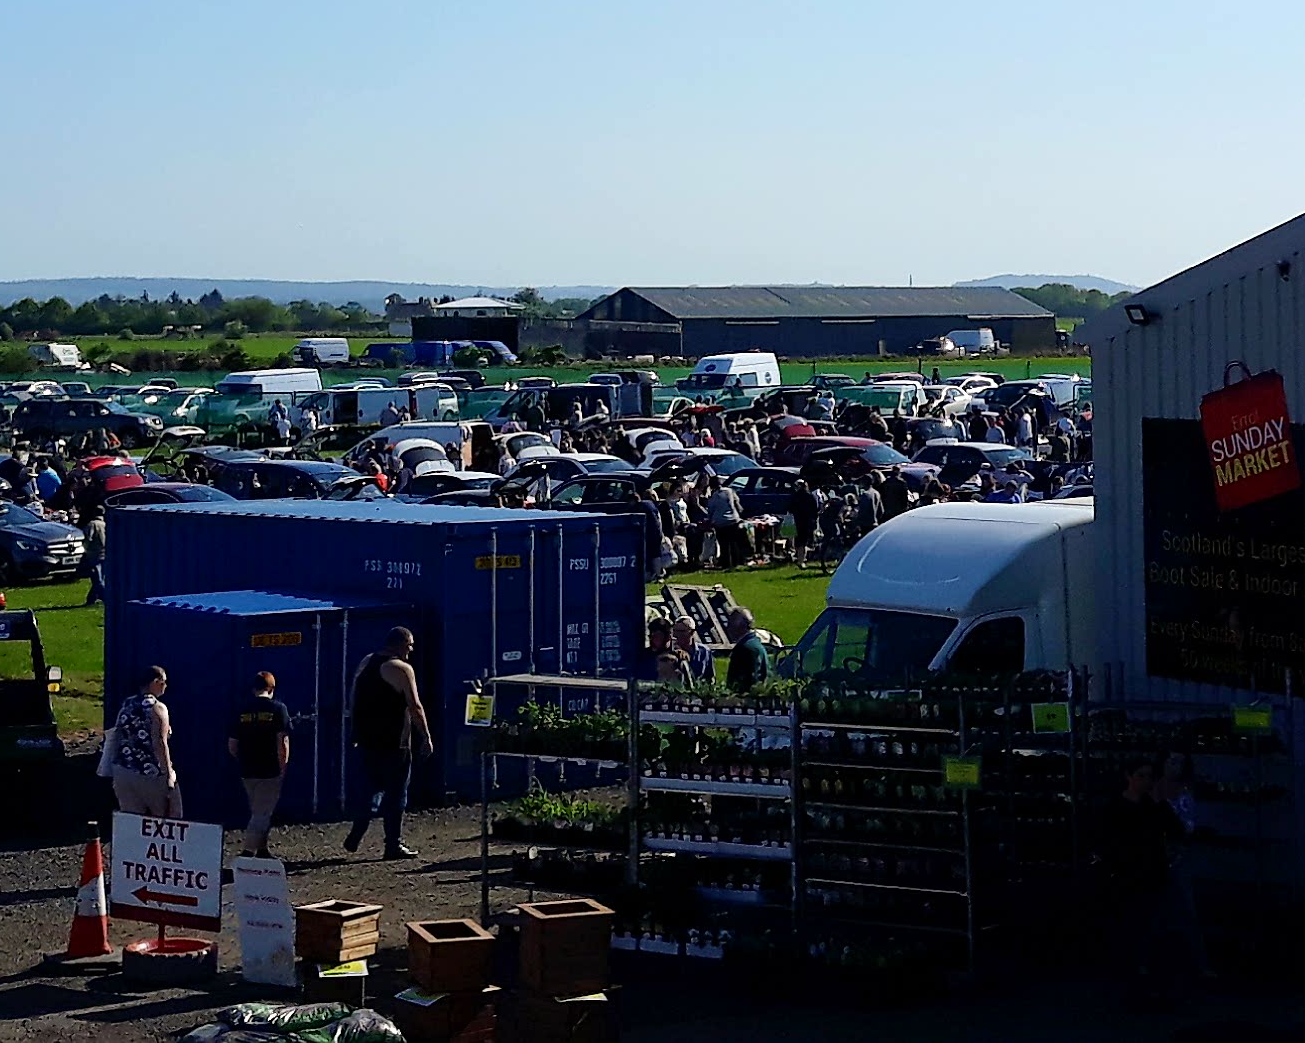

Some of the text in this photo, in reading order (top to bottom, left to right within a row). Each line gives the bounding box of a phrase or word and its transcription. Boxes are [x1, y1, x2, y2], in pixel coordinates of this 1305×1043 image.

[1212, 416, 1284, 462] SUNDAY
[1215, 440, 1290, 486] MARKET
[1162, 529, 1245, 557] Scotland's
[1150, 561, 1184, 585] Boot
[1190, 565, 1223, 589] Sale
[1229, 569, 1239, 590] &
[1245, 573, 1298, 596] Indoor
[141, 818, 189, 841] EXIT
[146, 843, 183, 863] ALL
[123, 861, 208, 890] TRAFFIC
